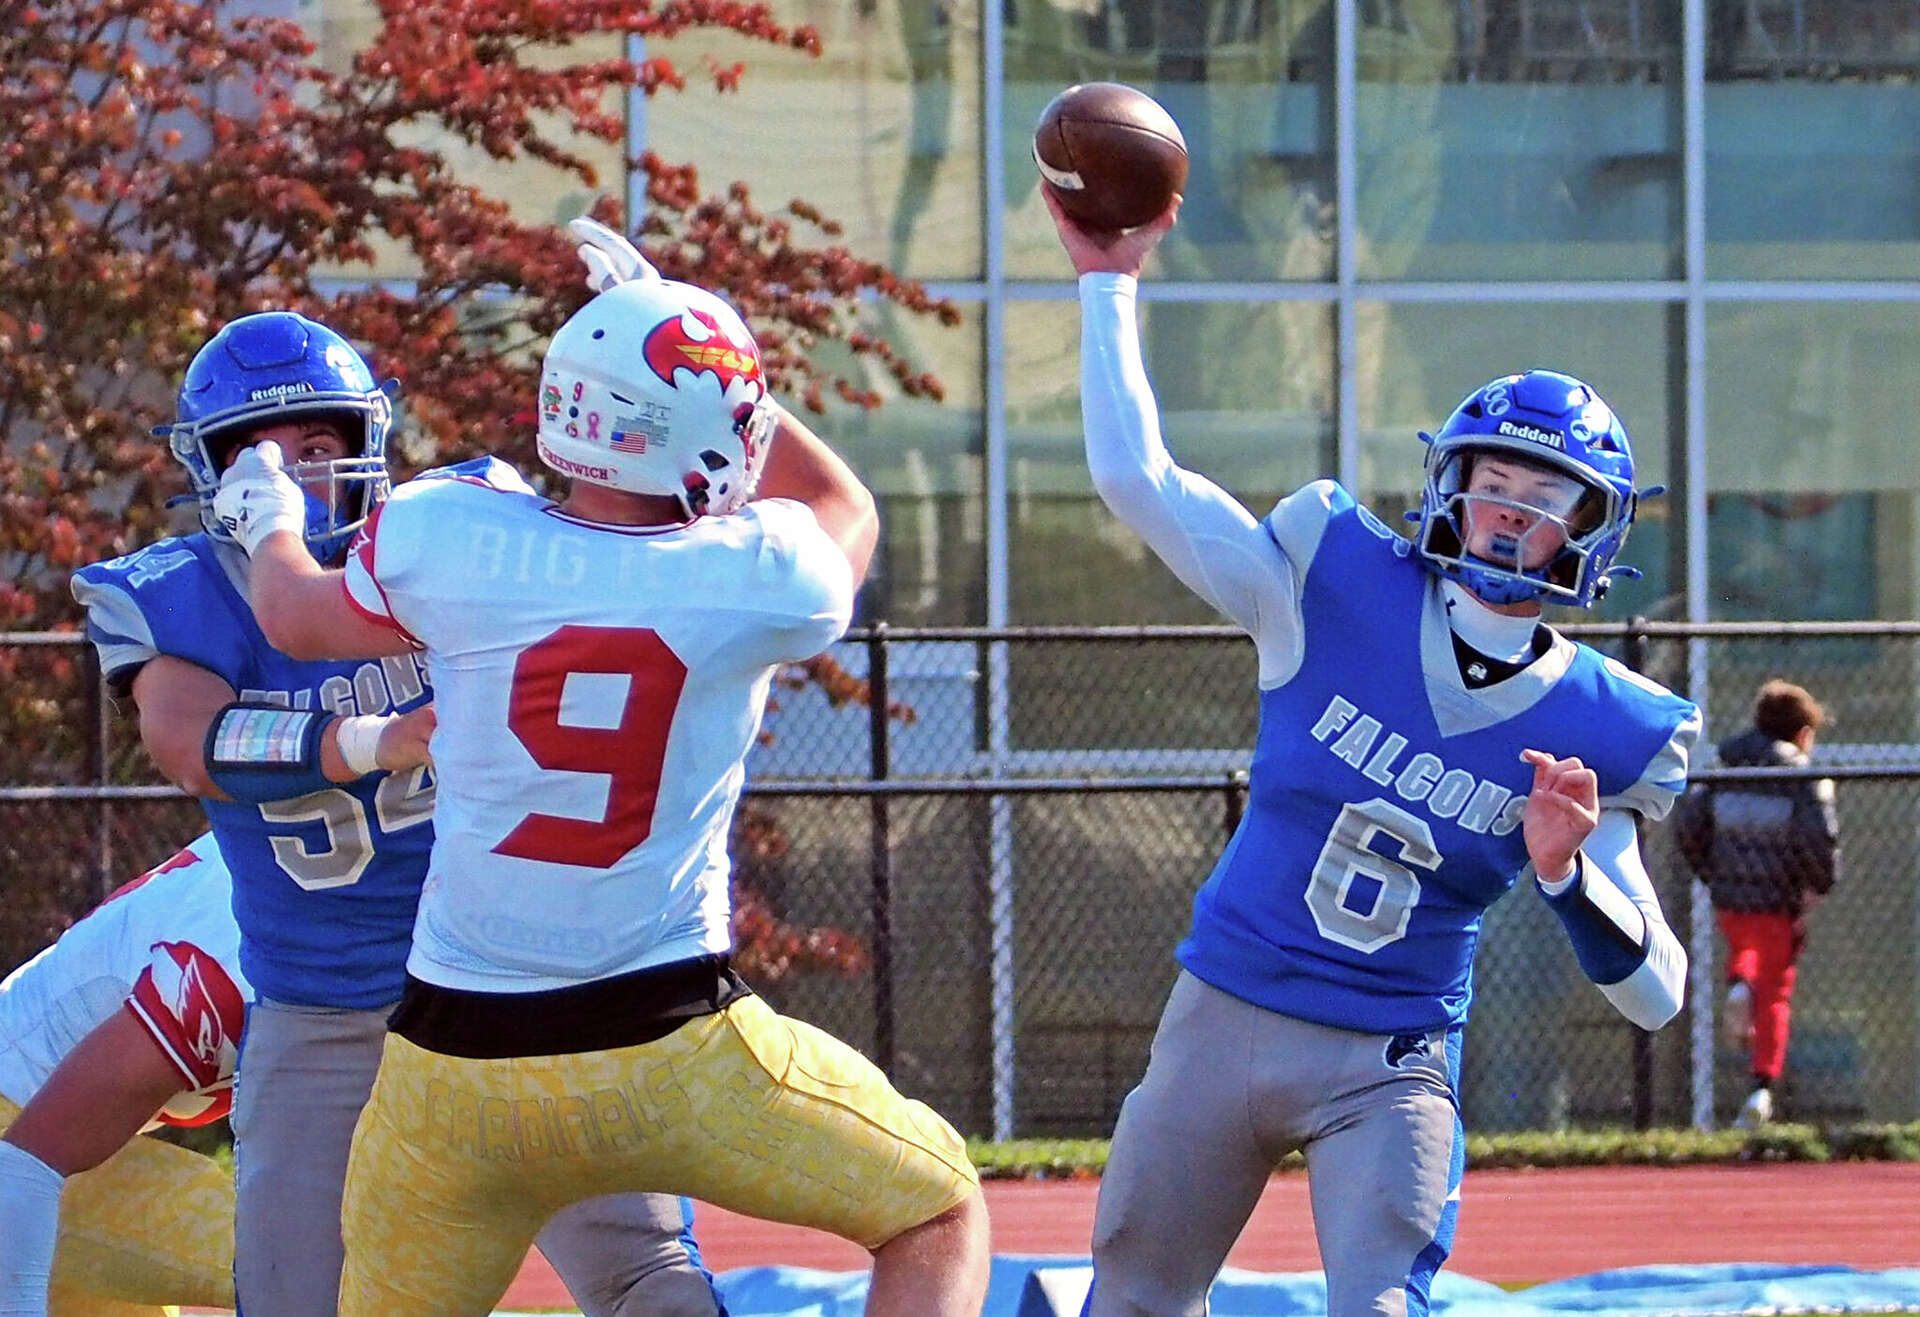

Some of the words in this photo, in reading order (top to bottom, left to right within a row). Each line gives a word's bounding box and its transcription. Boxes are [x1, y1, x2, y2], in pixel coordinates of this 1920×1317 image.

[251, 382, 306, 401] Riddell
[1499, 421, 1562, 448] Riddell
[489, 624, 688, 869] 9
[1310, 694, 1528, 836] FALCONS
[1303, 797, 1444, 955] 6
